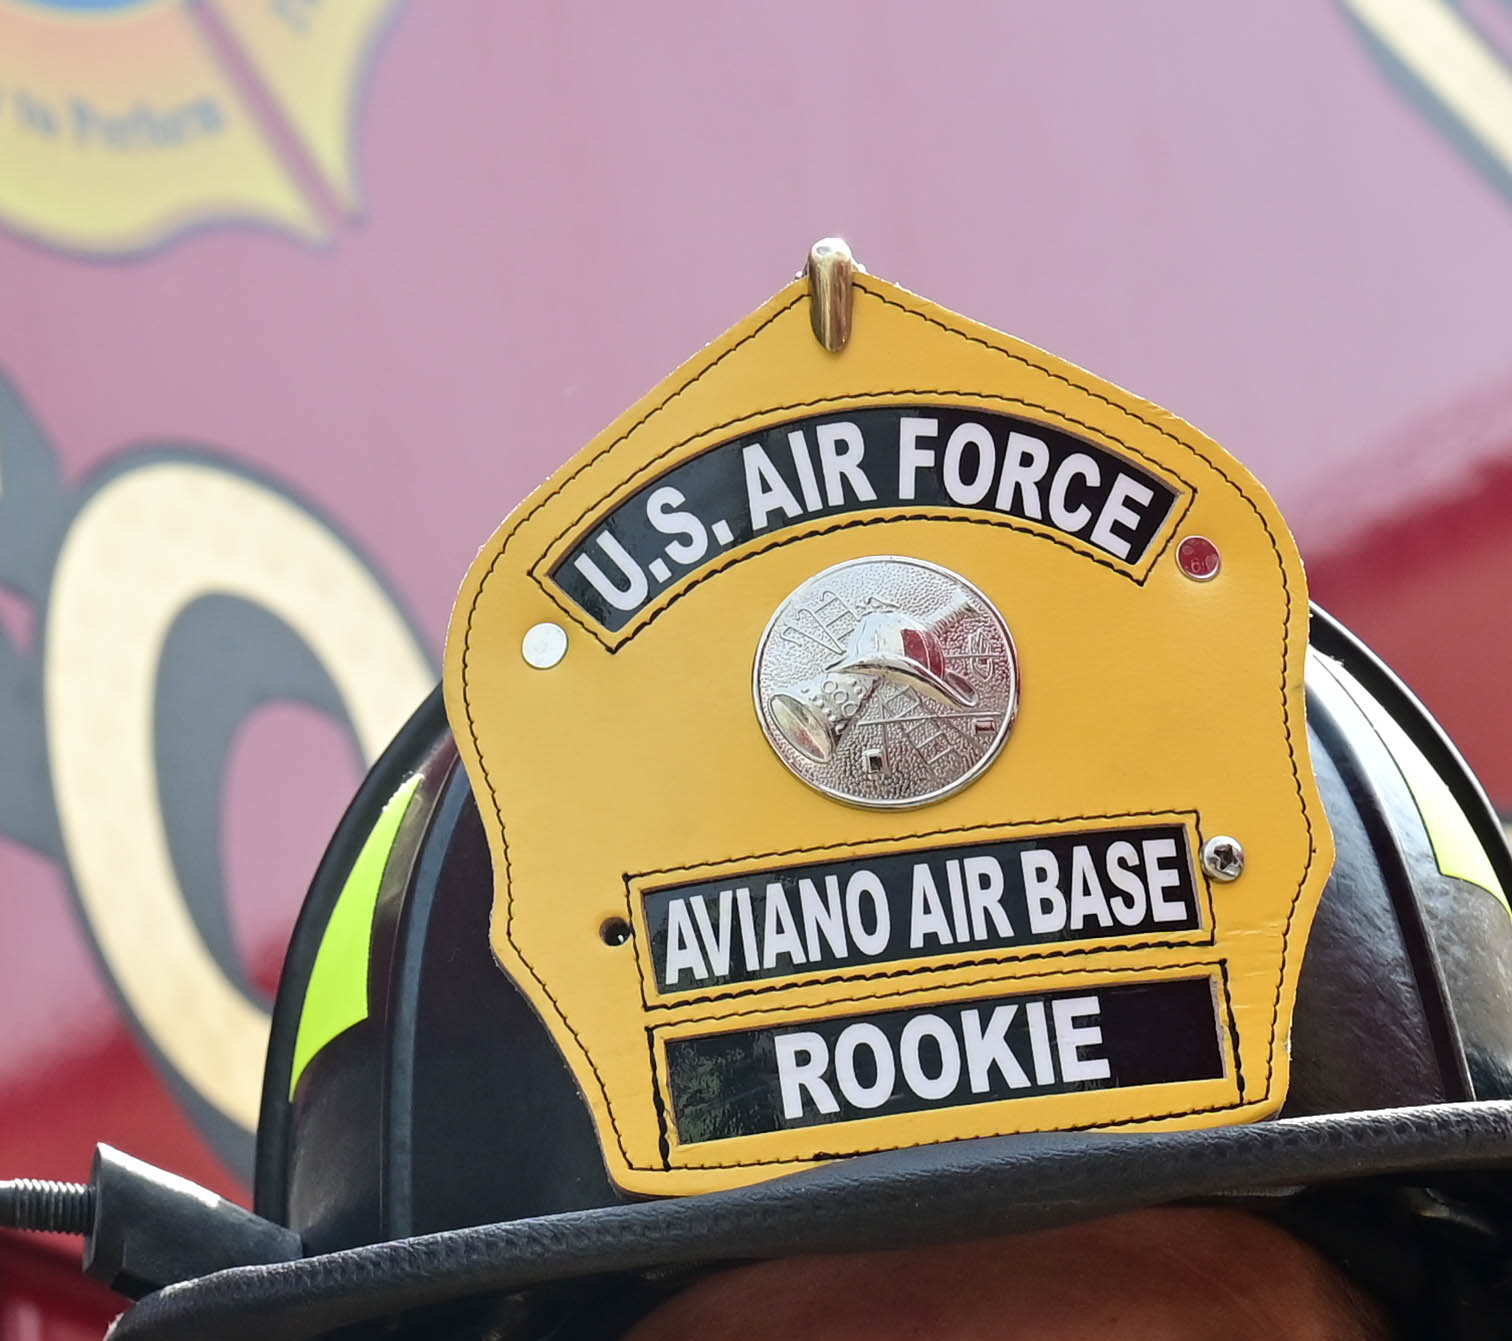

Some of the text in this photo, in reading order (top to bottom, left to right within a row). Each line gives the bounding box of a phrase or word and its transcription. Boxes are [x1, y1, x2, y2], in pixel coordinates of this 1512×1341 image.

[574, 416, 1160, 612] U.S. AIR FORCE
[664, 836, 1188, 986] AVIANO AIR BASE
[775, 995, 1112, 1120] ROOKIE
